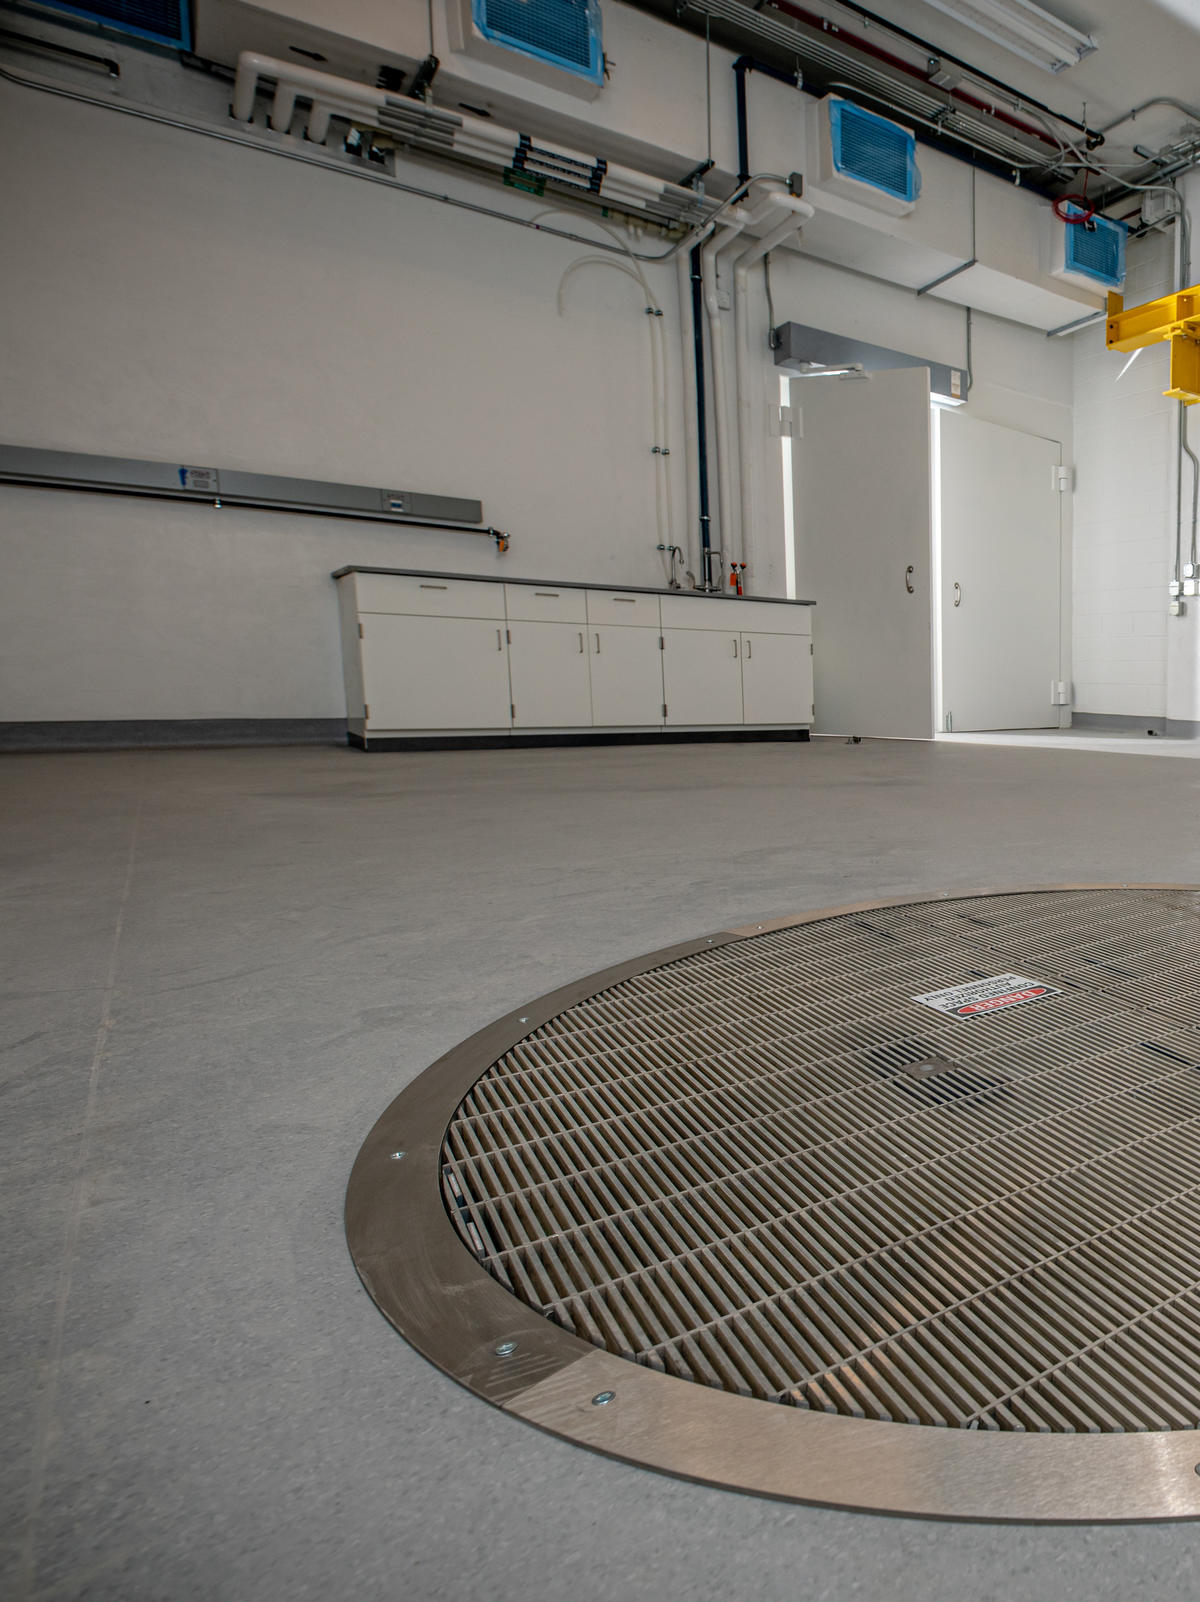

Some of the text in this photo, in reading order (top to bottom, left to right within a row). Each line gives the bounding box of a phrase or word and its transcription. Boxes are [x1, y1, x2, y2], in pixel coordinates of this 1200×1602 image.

[923, 976, 1017, 1002] PERSONNEL ONLY
[938, 982, 1035, 1009] CONFINED SPACE
[944, 982, 1012, 1001] AUTHORIZED
[970, 991, 1037, 1011] DANGER
